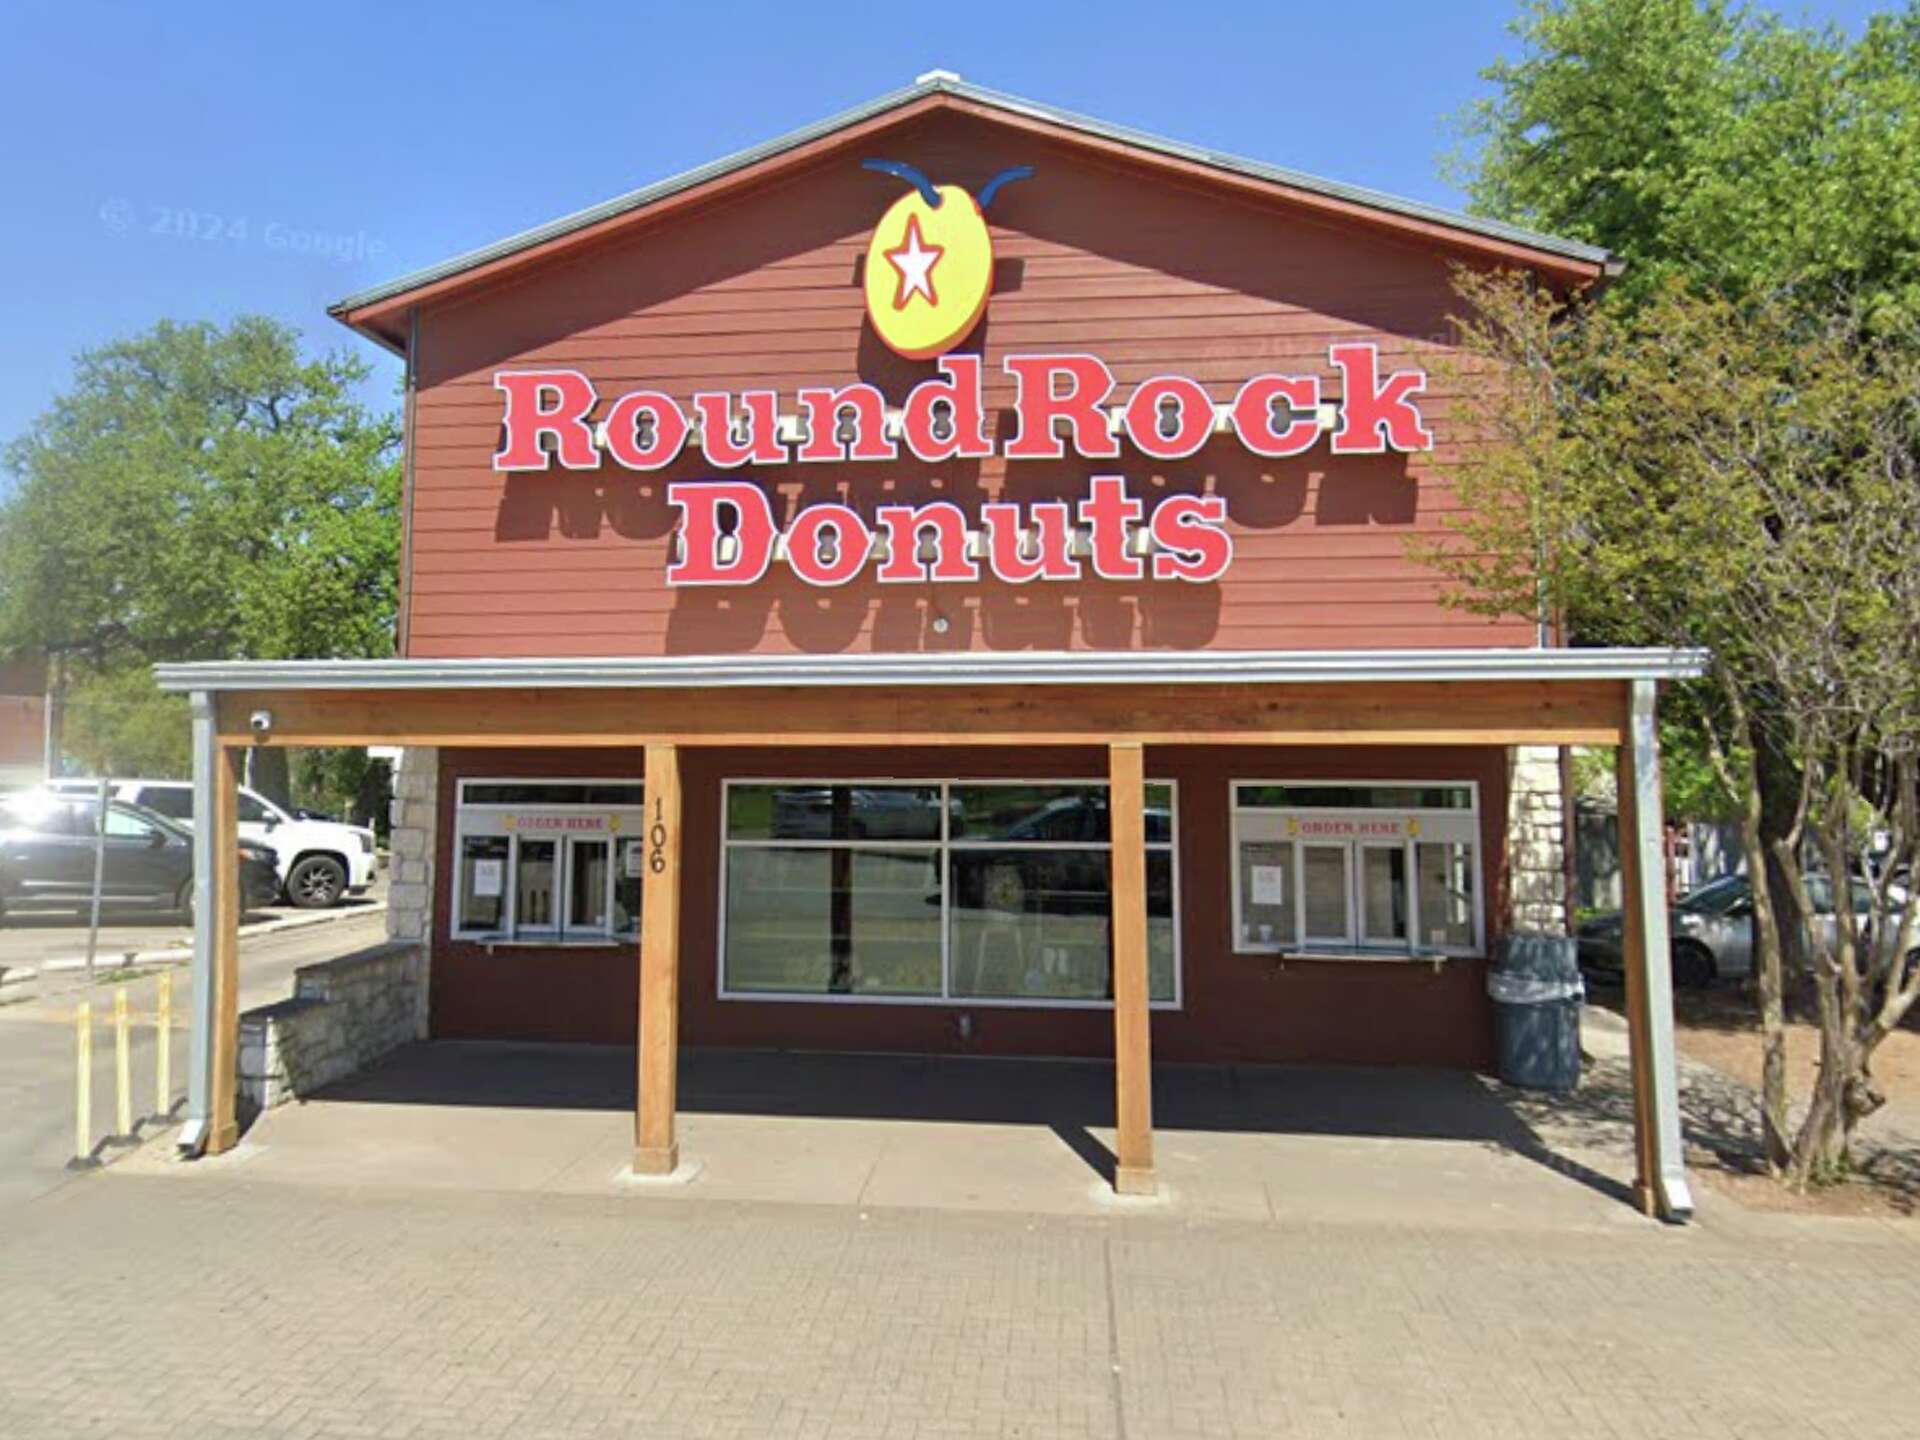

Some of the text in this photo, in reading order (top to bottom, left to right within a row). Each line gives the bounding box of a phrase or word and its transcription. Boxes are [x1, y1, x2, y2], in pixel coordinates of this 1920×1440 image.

[492, 343, 1434, 471] Round Rock
[666, 474, 1233, 587] Donuts
[650, 797, 667, 873] 106
